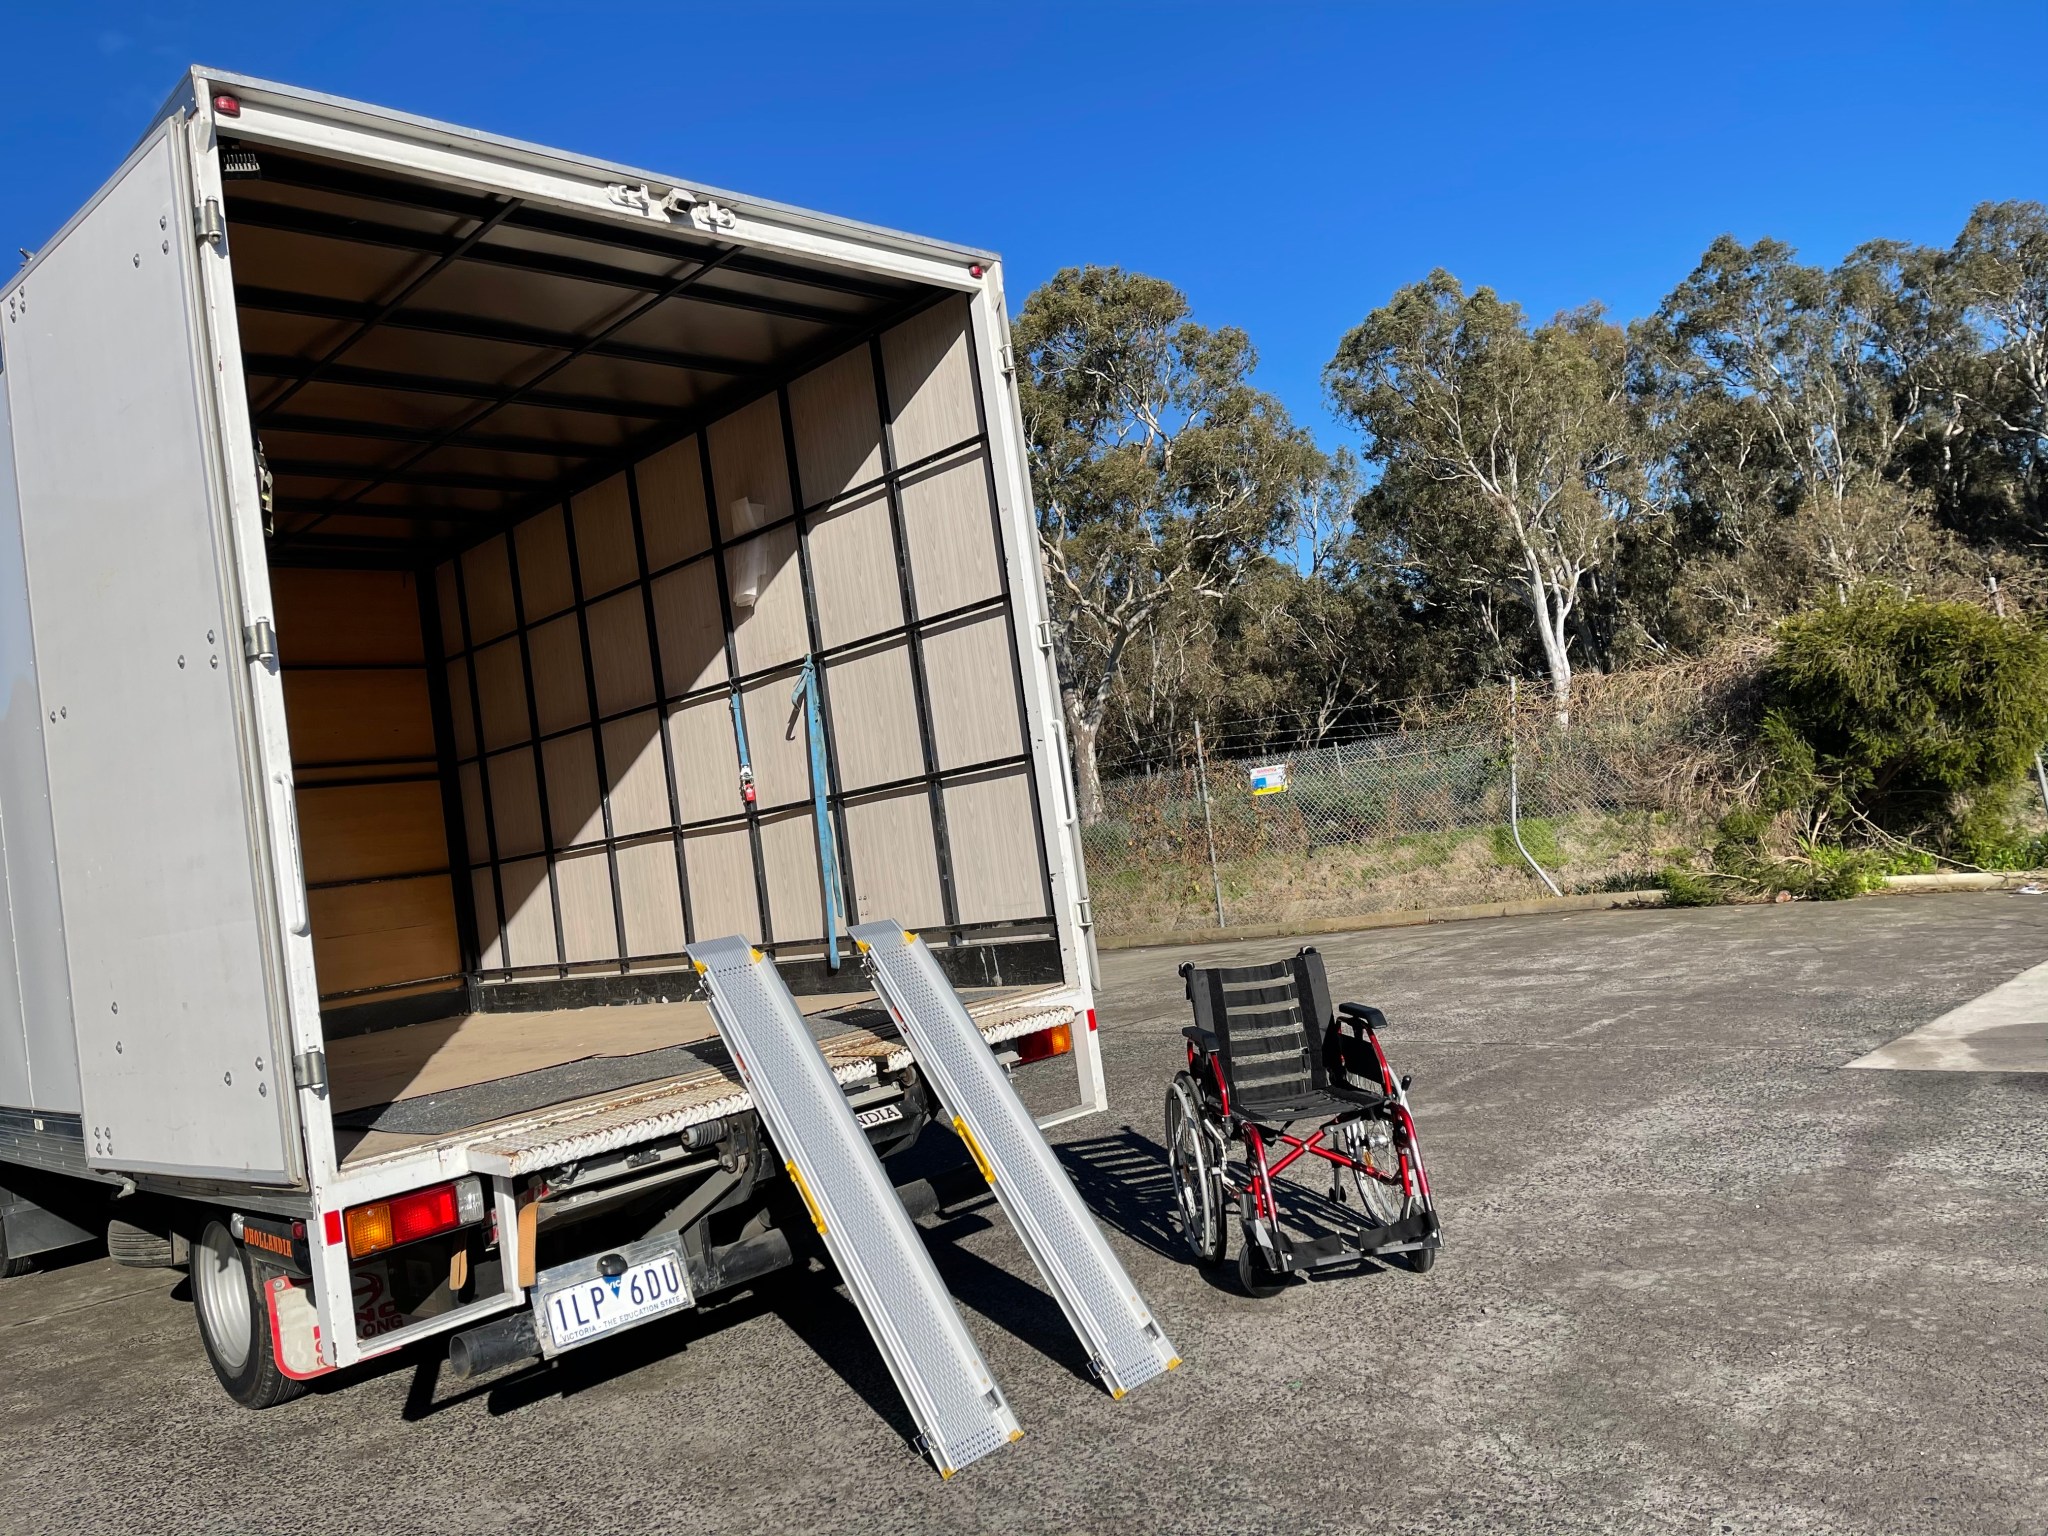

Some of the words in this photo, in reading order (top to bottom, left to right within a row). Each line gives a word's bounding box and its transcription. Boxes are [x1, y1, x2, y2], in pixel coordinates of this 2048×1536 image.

[244, 1226, 292, 1258] DHOLLANDIA
[555, 1286, 605, 1331] 1LP
[630, 1262, 680, 1306] 6DU
[360, 1315, 402, 1338] ONG
[562, 1325, 596, 1342] VICTORIA
[603, 1317, 618, 1328] THE
[619, 1304, 659, 1321] EDUCATION
[660, 1295, 681, 1309] STATE
